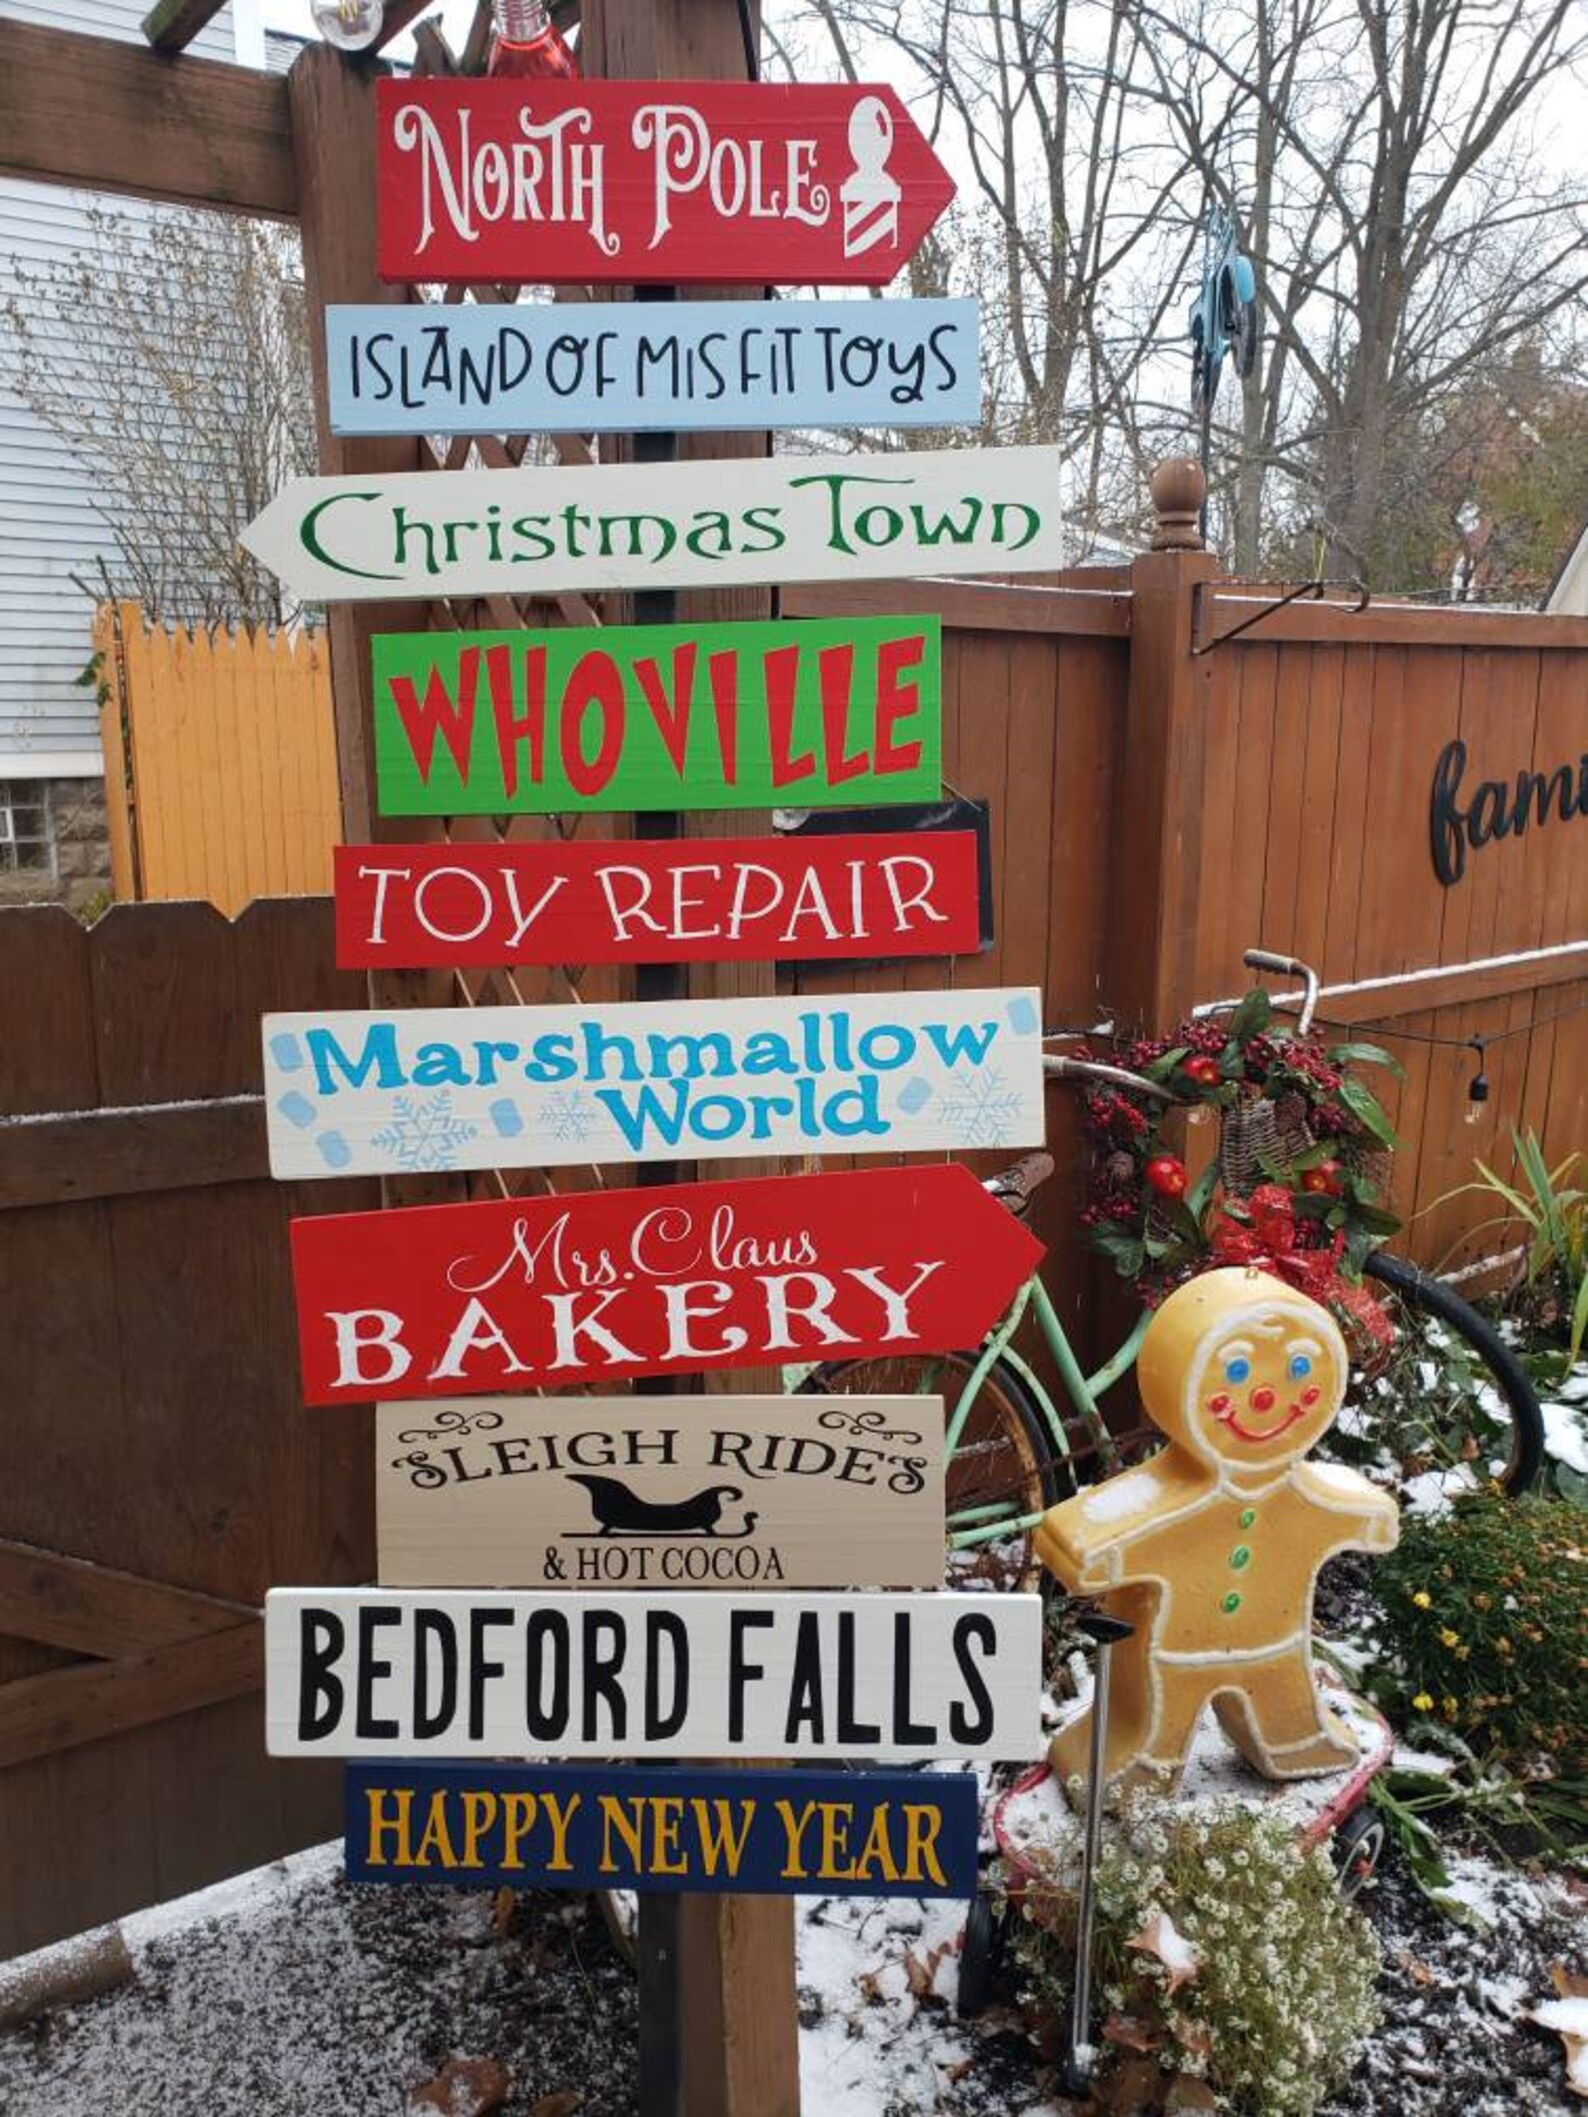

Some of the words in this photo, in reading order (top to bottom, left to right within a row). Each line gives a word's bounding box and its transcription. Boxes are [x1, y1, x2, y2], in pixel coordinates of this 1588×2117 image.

[393, 104, 620, 256] NORTH
[631, 103, 831, 251] POLE
[349, 325, 532, 409] ISLAND
[546, 333, 619, 399] OF
[637, 327, 802, 401] MISFIT
[815, 323, 958, 403] TOYS
[299, 492, 787, 581] Christmas
[789, 474, 1041, 556] Town
[388, 635, 925, 798] WHOVILLE
[358, 865, 568, 947] TOY
[595, 856, 948, 942] REPAIR
[305, 1012, 998, 1096] Marshmallow
[596, 1074, 890, 1153] World
[446, 1210, 634, 1292] Mrs.
[629, 1204, 819, 1276] Claus
[324, 1260, 946, 1389] BAKERY
[391, 1429, 679, 1490] SLEIGH
[543, 1546, 566, 1581] &
[577, 1545, 654, 1581] HOT
[661, 1545, 786, 1582] COCOA
[298, 1606, 690, 1742] BEDFORD
[729, 1609, 997, 1746] FALLS
[364, 1787, 581, 1871] HAPPY
[598, 1795, 756, 1878] NEW
[774, 1800, 947, 1888] YEAR
